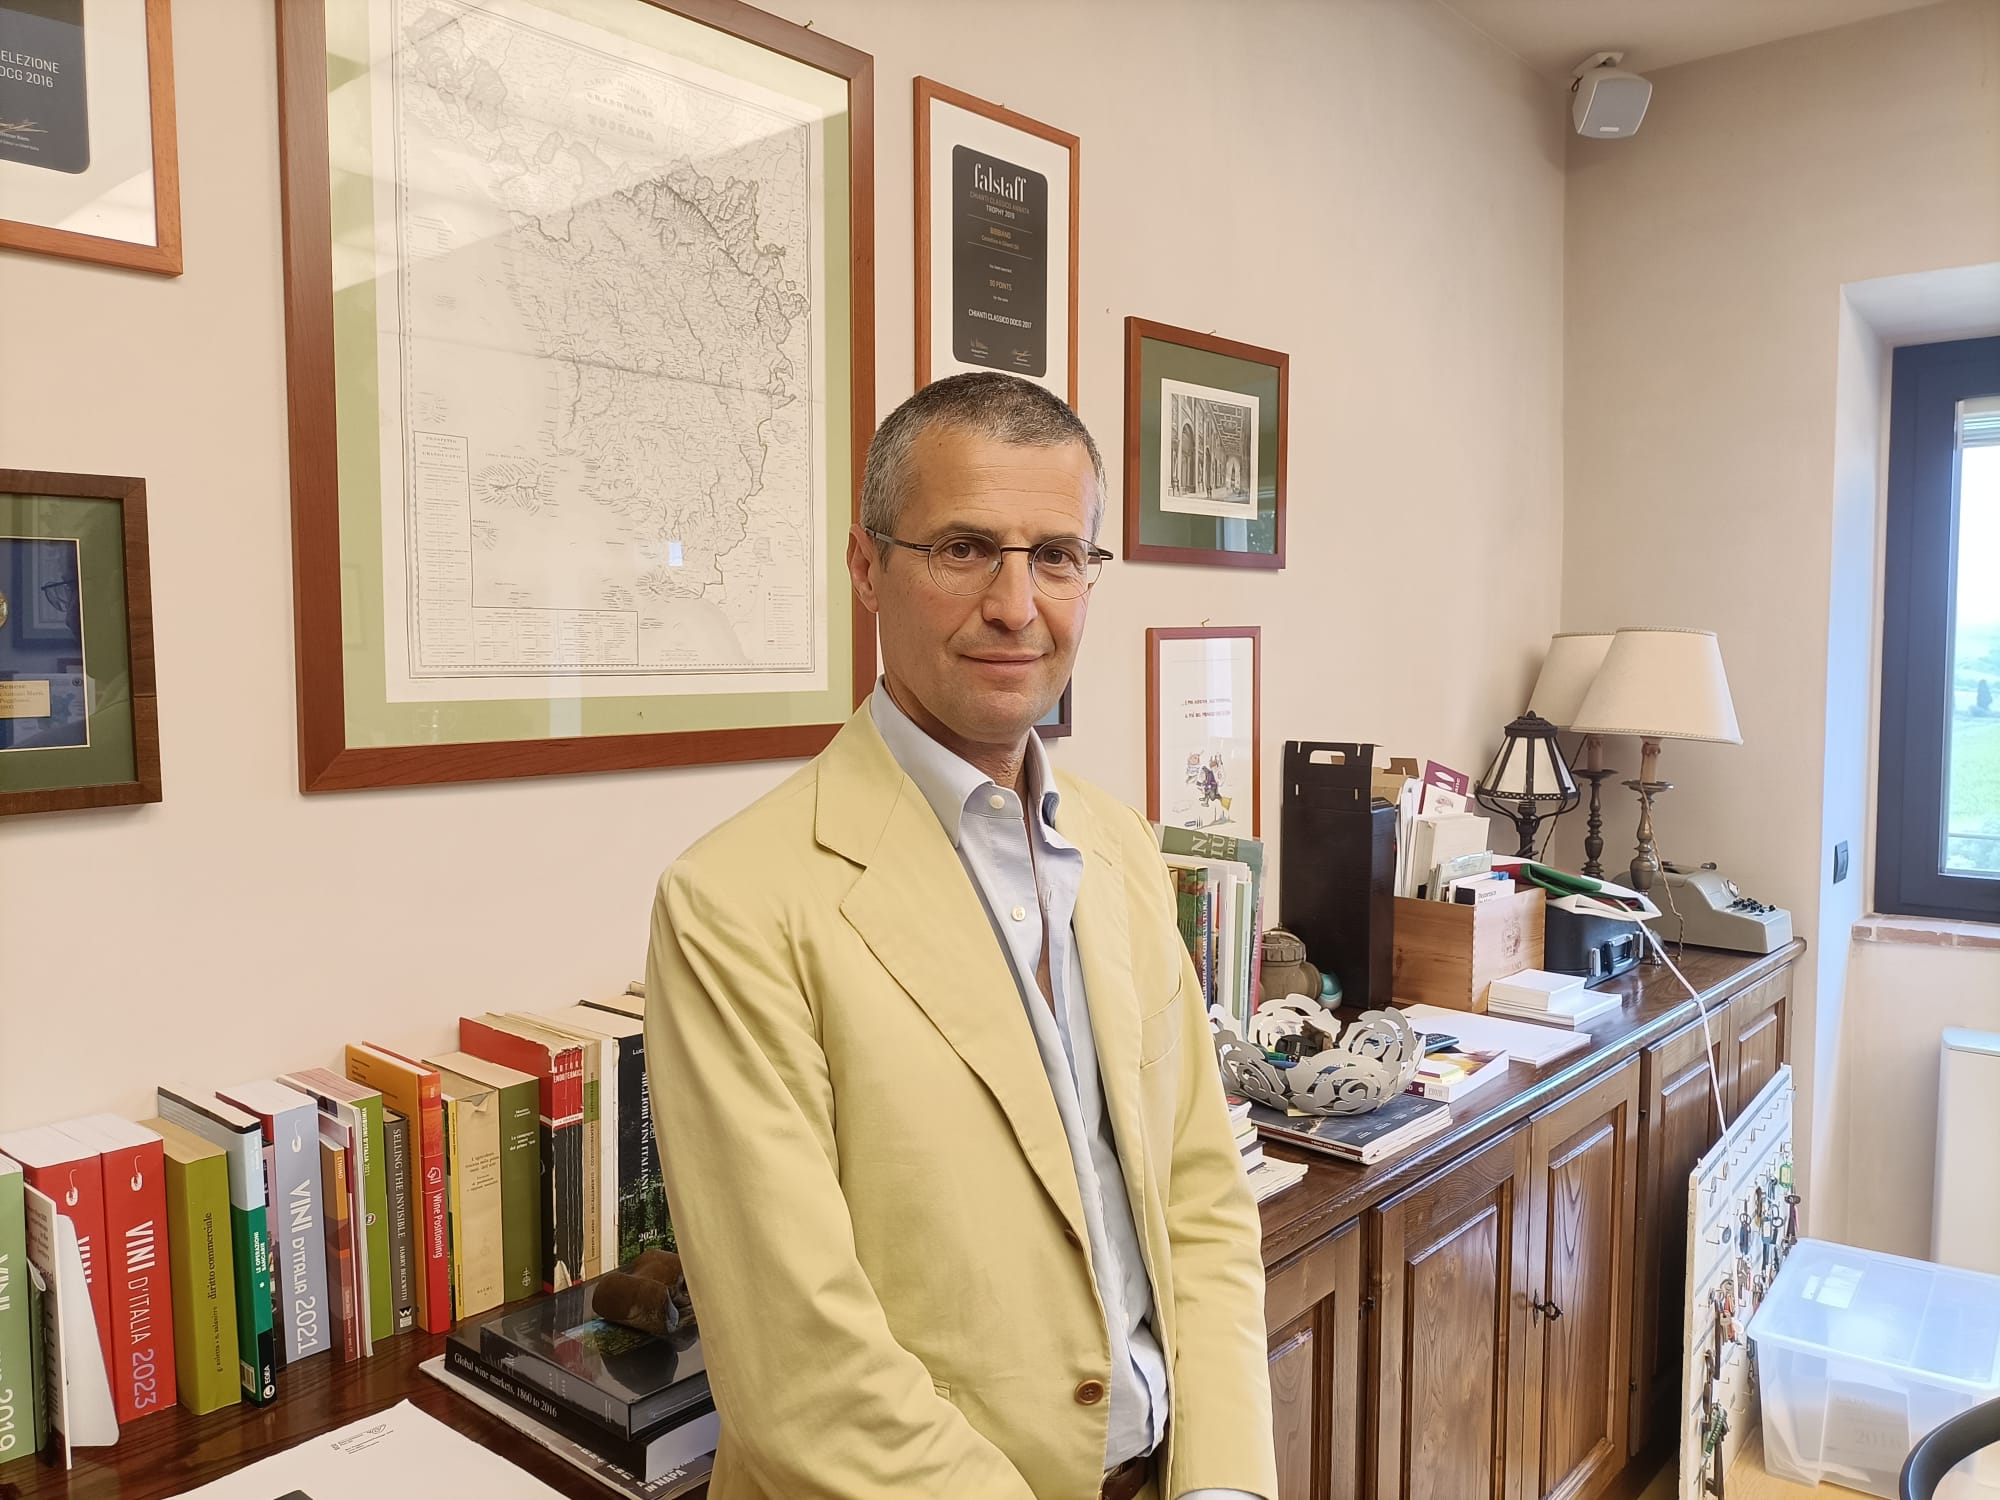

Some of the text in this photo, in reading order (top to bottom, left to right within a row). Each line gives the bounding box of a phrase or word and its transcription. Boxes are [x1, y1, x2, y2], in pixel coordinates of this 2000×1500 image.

[26, 71, 54, 88] 2016
[974, 163, 1027, 203] falstaff
[986, 204, 1004, 216] TROPHY
[996, 281, 1012, 291] POINTS
[968, 308, 1033, 329] CHIANTI CLASSICO DOCG 2017
[641, 1072, 649, 1121] MIGLIORI
[641, 1122, 649, 1144] VINI
[393, 1128, 408, 1301] SELLING THE INVISIBLE HARRY BECKWITH
[432, 1193, 444, 1259] Wine Positioning
[253, 1231, 262, 1266] OPERAZIONI
[638, 1227, 658, 1243] 2021
[203, 1212, 218, 1300] diritto commerciale
[289, 1179, 319, 1356] VINI D'ITALIA 2021
[126, 1220, 157, 1410] VINI D'ITALIA 2023
[263, 1365, 271, 1384] EGEA
[454, 1352, 558, 1417] Global wine markets, 1860 to 2016
[656, 1469, 688, 1487] NAPA
